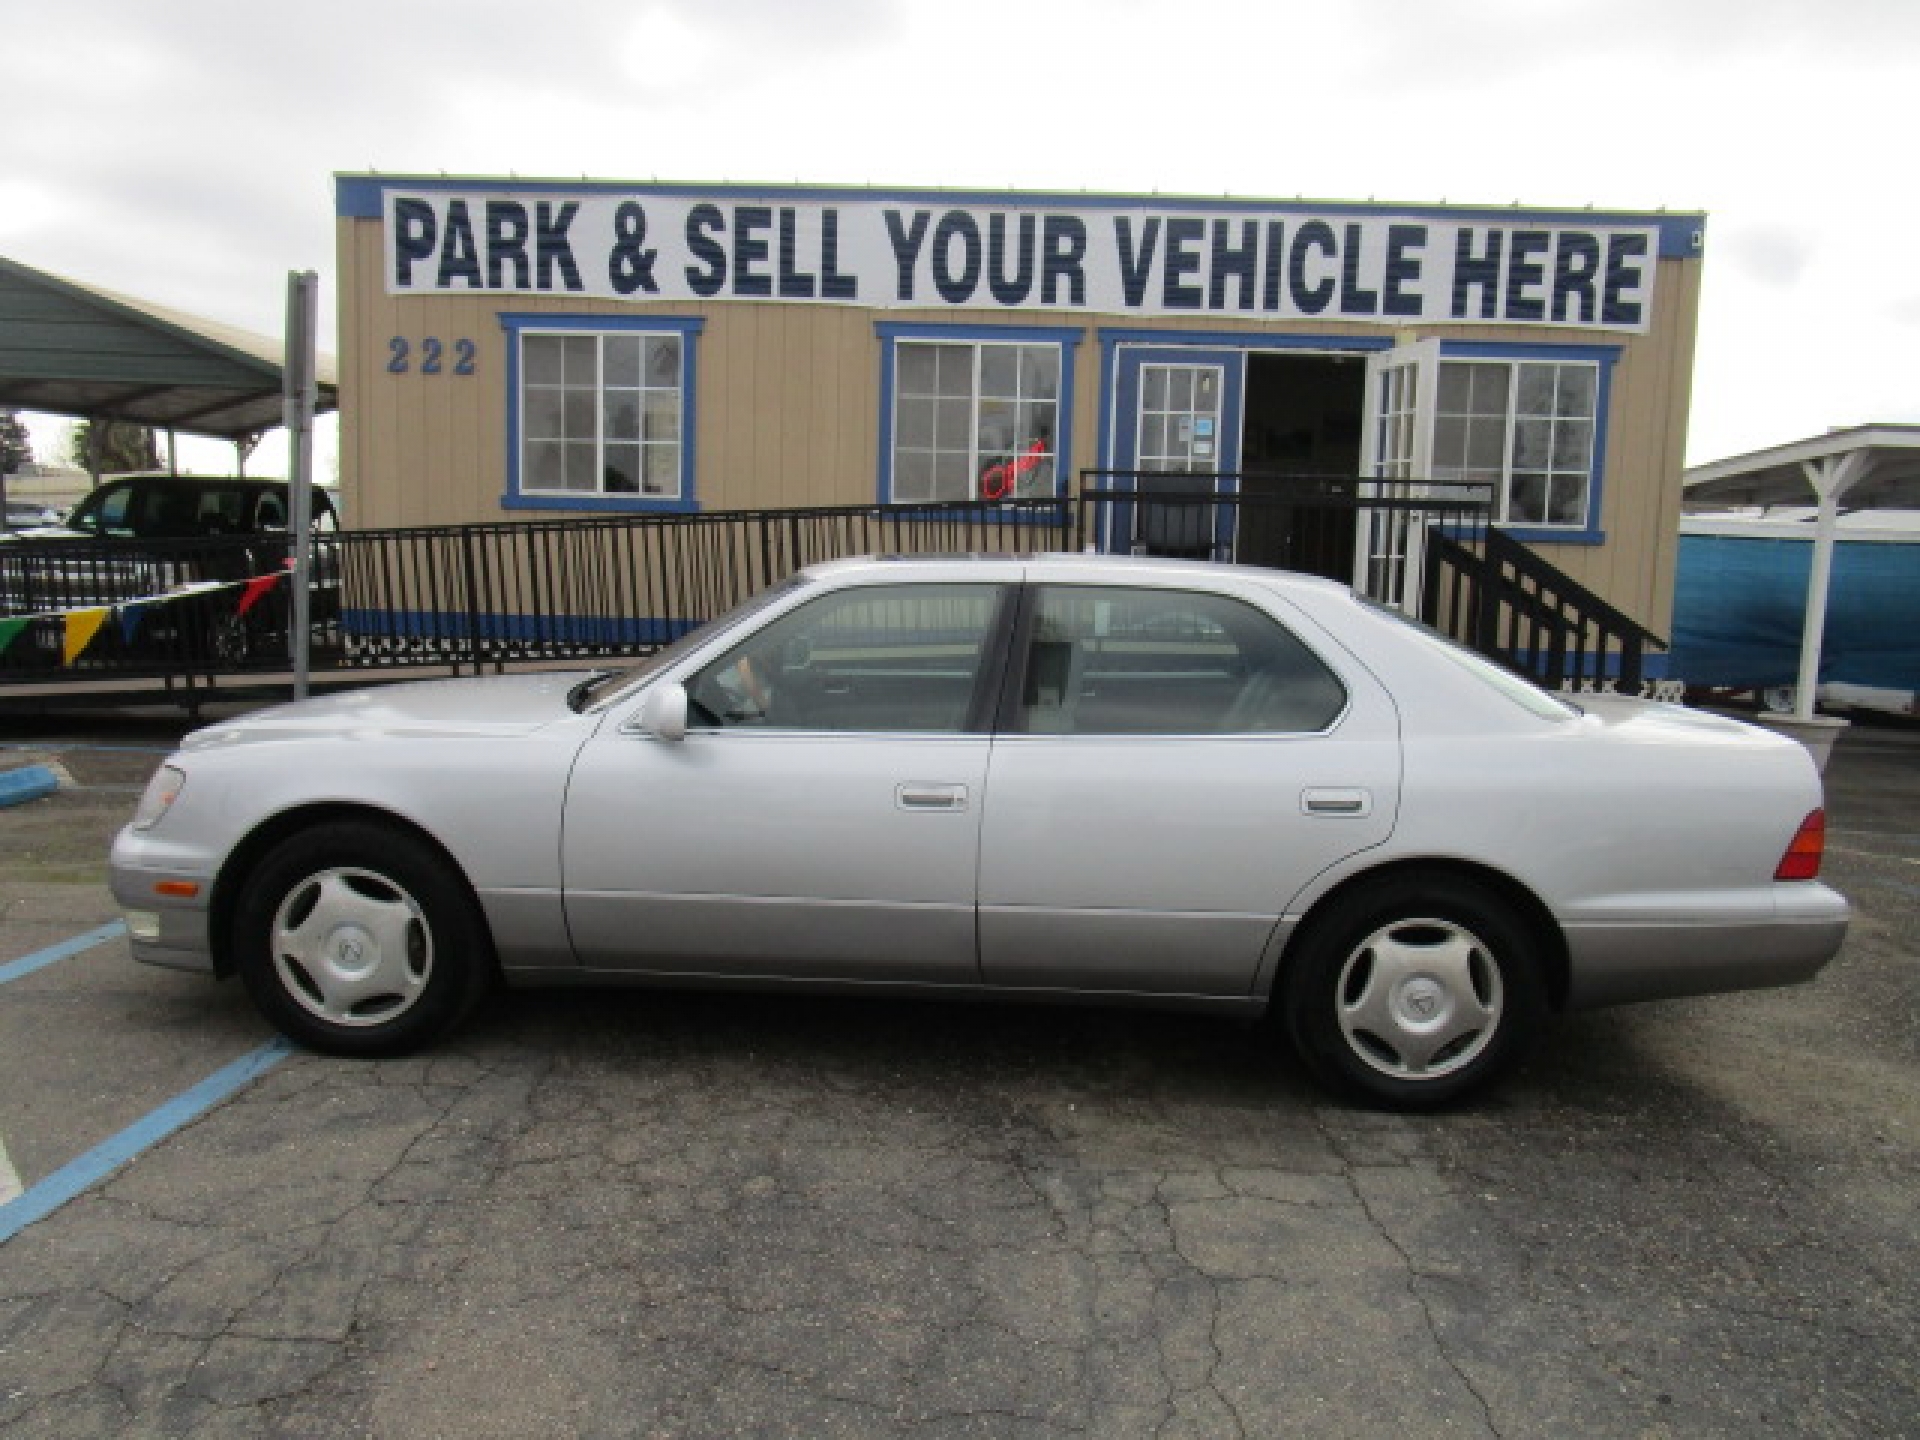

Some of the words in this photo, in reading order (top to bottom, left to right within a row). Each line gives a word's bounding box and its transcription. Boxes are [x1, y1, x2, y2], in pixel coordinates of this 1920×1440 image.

[394, 197, 584, 290] PARK
[608, 200, 660, 295] &
[684, 203, 858, 298] SELL
[885, 209, 1088, 307] YOUR
[1114, 215, 1428, 315] VEHICLE
[1450, 227, 1648, 324] HERE
[386, 336, 477, 375] 222
